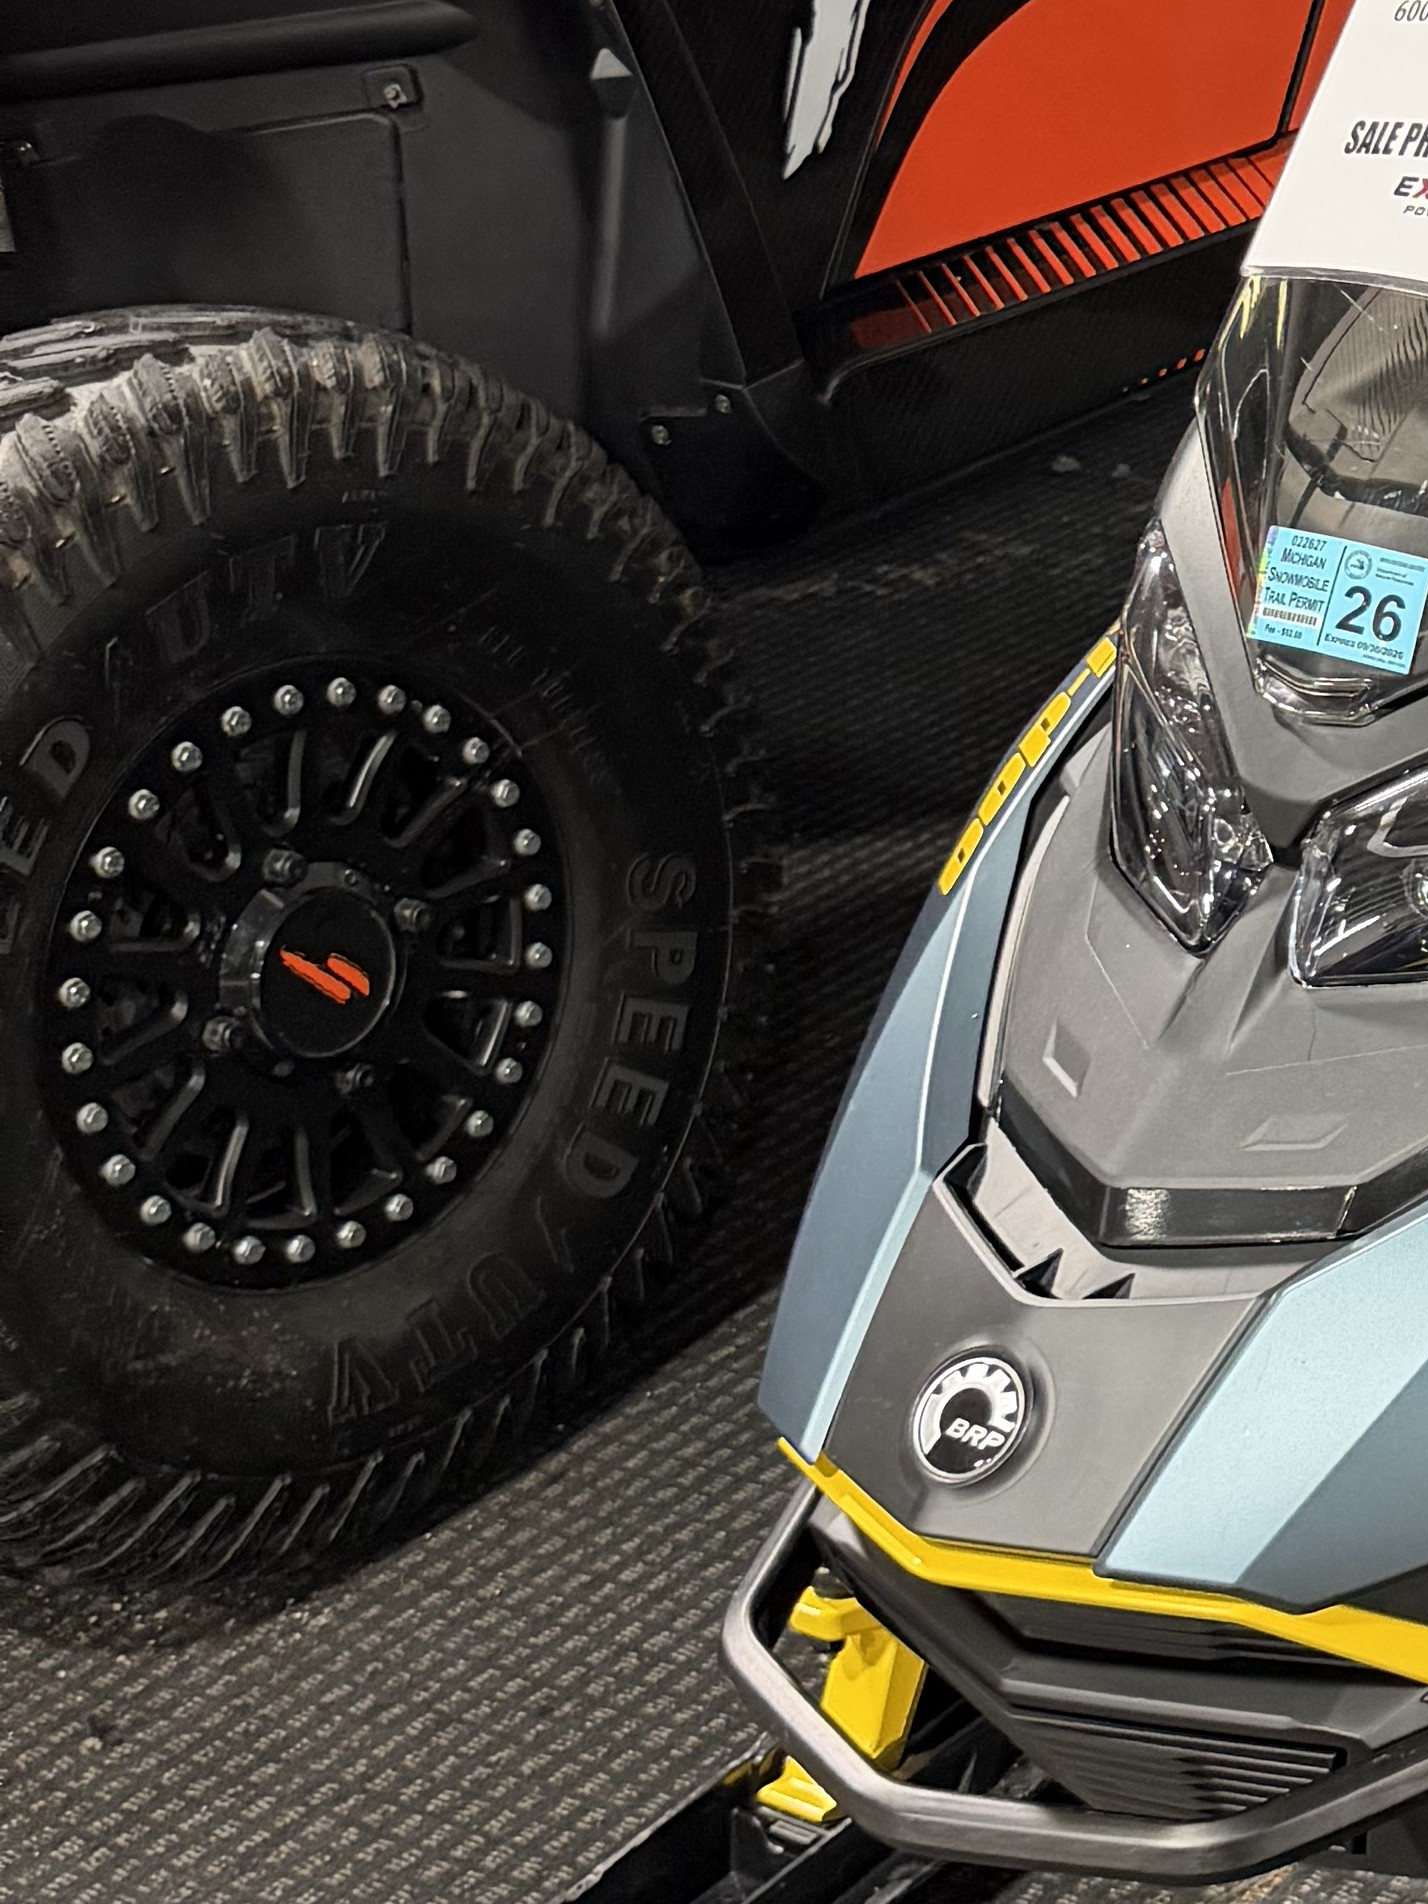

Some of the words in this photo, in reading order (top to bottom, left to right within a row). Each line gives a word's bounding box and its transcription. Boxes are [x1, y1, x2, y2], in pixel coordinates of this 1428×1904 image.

[1344, 120, 1404, 155] SALE
[1287, 591, 1326, 613] PERMIT
[1335, 585, 1406, 643] 26
[945, 1417, 1005, 1450] BRP
